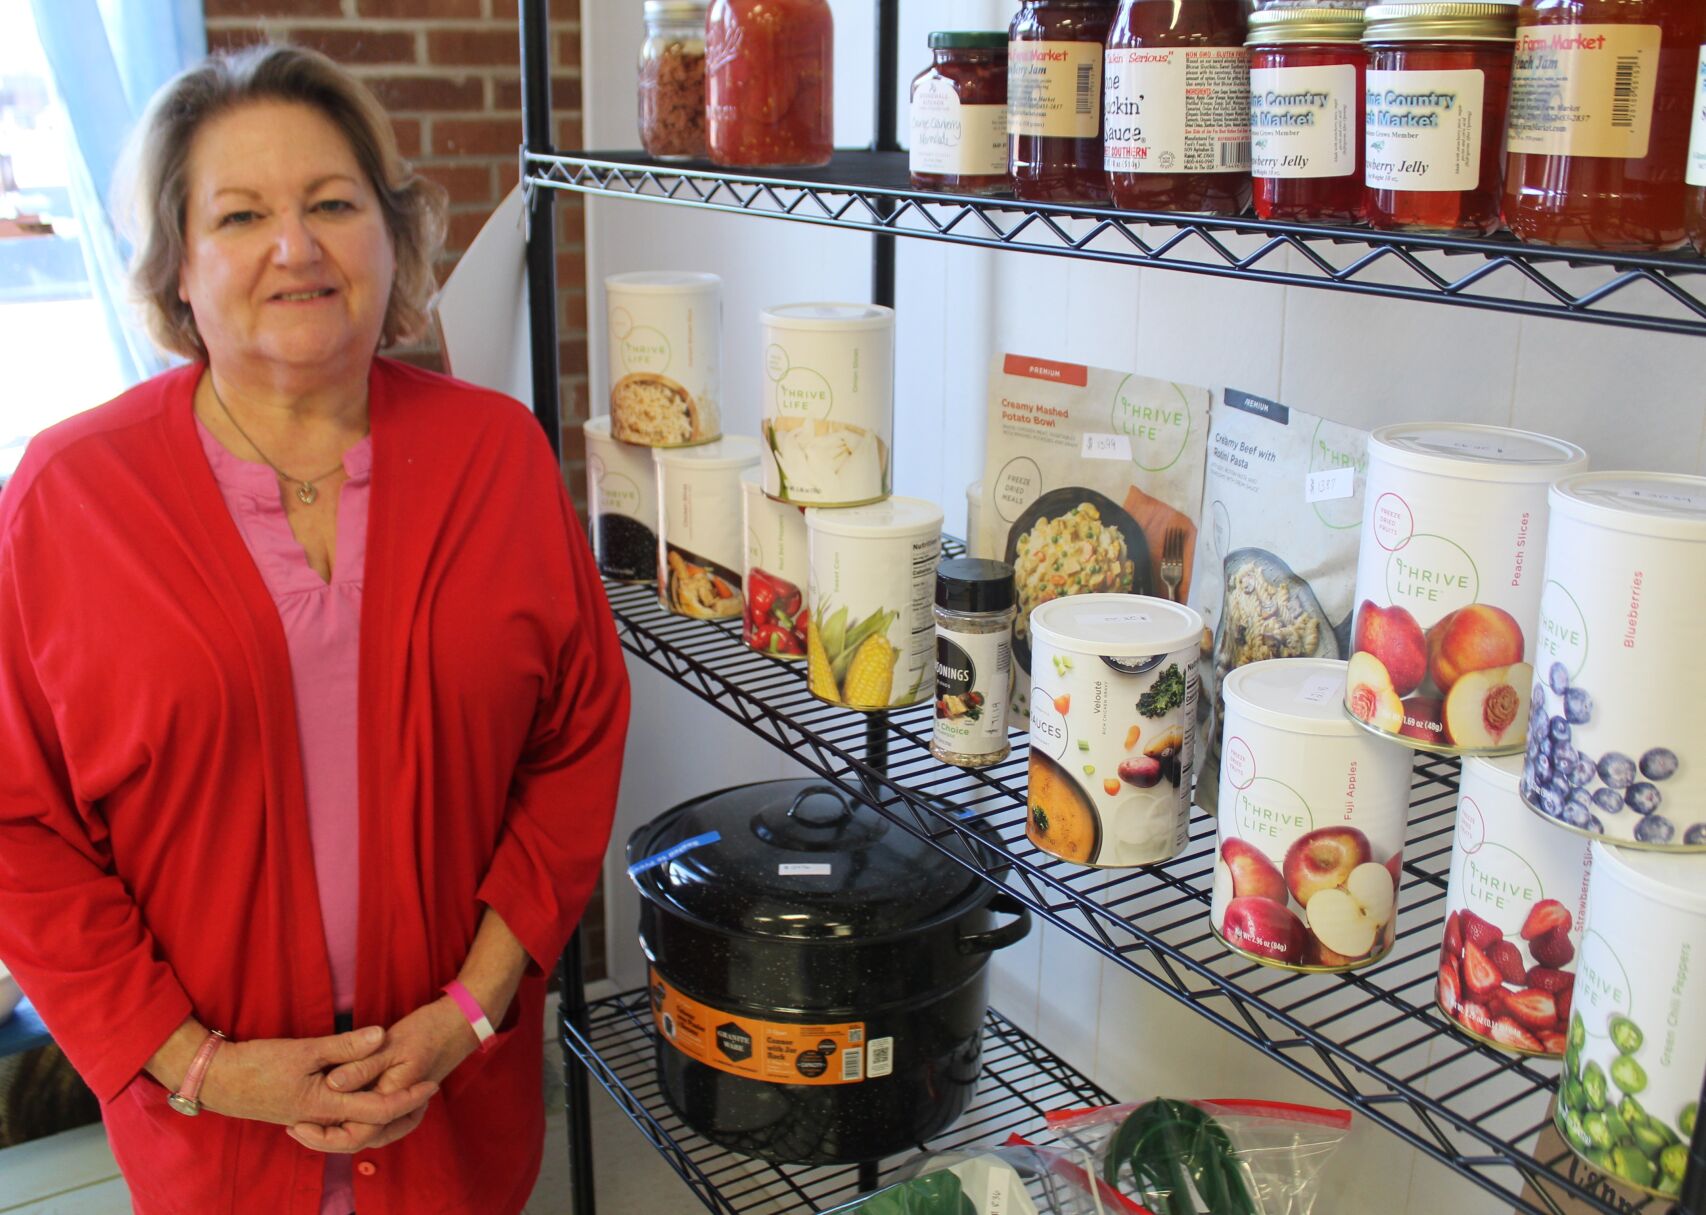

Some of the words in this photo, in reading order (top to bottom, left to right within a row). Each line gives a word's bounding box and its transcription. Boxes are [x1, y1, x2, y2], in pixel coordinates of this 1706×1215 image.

[1551, 33, 1606, 50] Market
[1032, 49, 1069, 61] Market
[1536, 56, 1558, 70] Jam
[1266, 90, 1329, 108] Country
[1385, 90, 1456, 110] Country
[1260, 111, 1314, 127] Market
[1377, 110, 1438, 128] Market
[1111, 146, 1147, 157] SOUTHERN
[1281, 154, 1309, 169] Jelly
[1398, 160, 1429, 176] Jelly
[625, 341, 665, 354] THRIVE
[1029, 366, 1061, 377] PREMIUM
[781, 384, 826, 401] THRIVE
[783, 400, 809, 411] LIFE
[1002, 398, 1034, 413] Creamy
[1036, 404, 1069, 418] Mashed
[1121, 396, 1183, 426] THRIVE
[1002, 411, 1031, 423] Potato
[1034, 416, 1056, 427] Bowl
[1123, 420, 1157, 441] LIFE
[1215, 433, 1239, 450] Creamy
[1239, 441, 1257, 456] Beef
[1258, 449, 1276, 463] with
[1230, 454, 1249, 470] Pasta
[1008, 474, 1031, 486] FREEZE
[1004, 484, 1024, 494] DRIED
[1002, 494, 1023, 505] MEALS
[1379, 515, 1396, 527] DRIED
[1380, 507, 1401, 520] FREEZE
[1378, 523, 1398, 536] FRUITS
[1517, 512, 1530, 547] Slices
[1396, 558, 1469, 589] THRIVE
[1511, 550, 1525, 587] Peach
[1397, 581, 1439, 602] LIFE
[1623, 570, 1644, 648] Blueberries
[1093, 680, 1102, 715] Velouté
[941, 722, 970, 736] Choice
[1403, 715, 1415, 727] 1.69
[1416, 720, 1424, 728] oz
[1424, 720, 1443, 733] (48g)
[1346, 761, 1357, 797] Apples
[1242, 795, 1304, 828] THRIVE
[1343, 801, 1355, 821] Fuji
[1244, 816, 1279, 838] LIFE
[1470, 861, 1533, 901] THRIVE
[1470, 883, 1505, 909] LIFE
[1574, 871, 1591, 933] Strawberry
[1659, 1029, 1674, 1067] Green
[1672, 943, 1691, 995] Peppers
[717, 1030, 750, 1044] GRANITE
[722, 1040, 745, 1053] WARE
